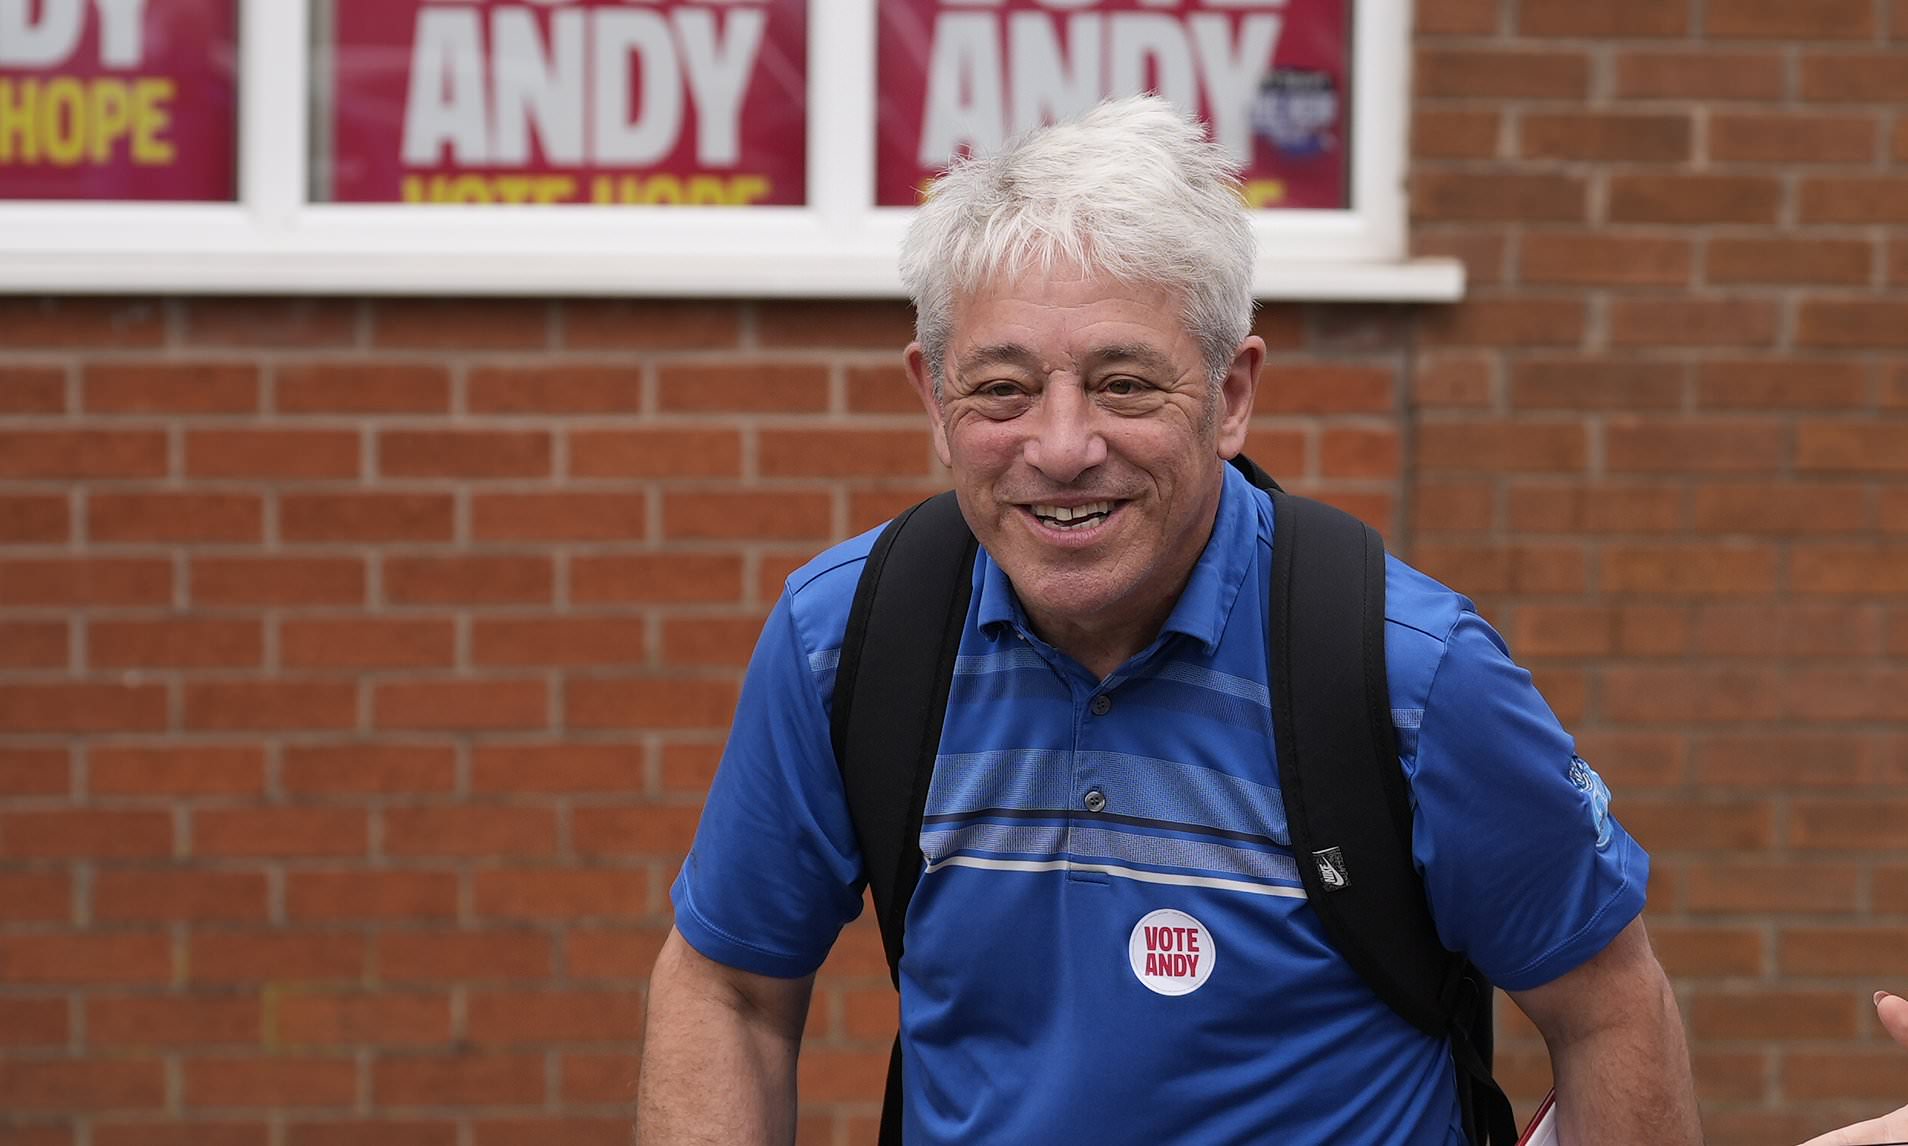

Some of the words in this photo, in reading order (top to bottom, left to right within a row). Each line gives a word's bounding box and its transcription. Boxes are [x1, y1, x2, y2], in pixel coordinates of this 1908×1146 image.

[0, 78, 176, 166] HOPE
[402, 7, 765, 166] ANDY
[918, 11, 1283, 167] ANDY
[1144, 926, 1199, 952] VOTE
[1145, 953, 1199, 977] ANDY
